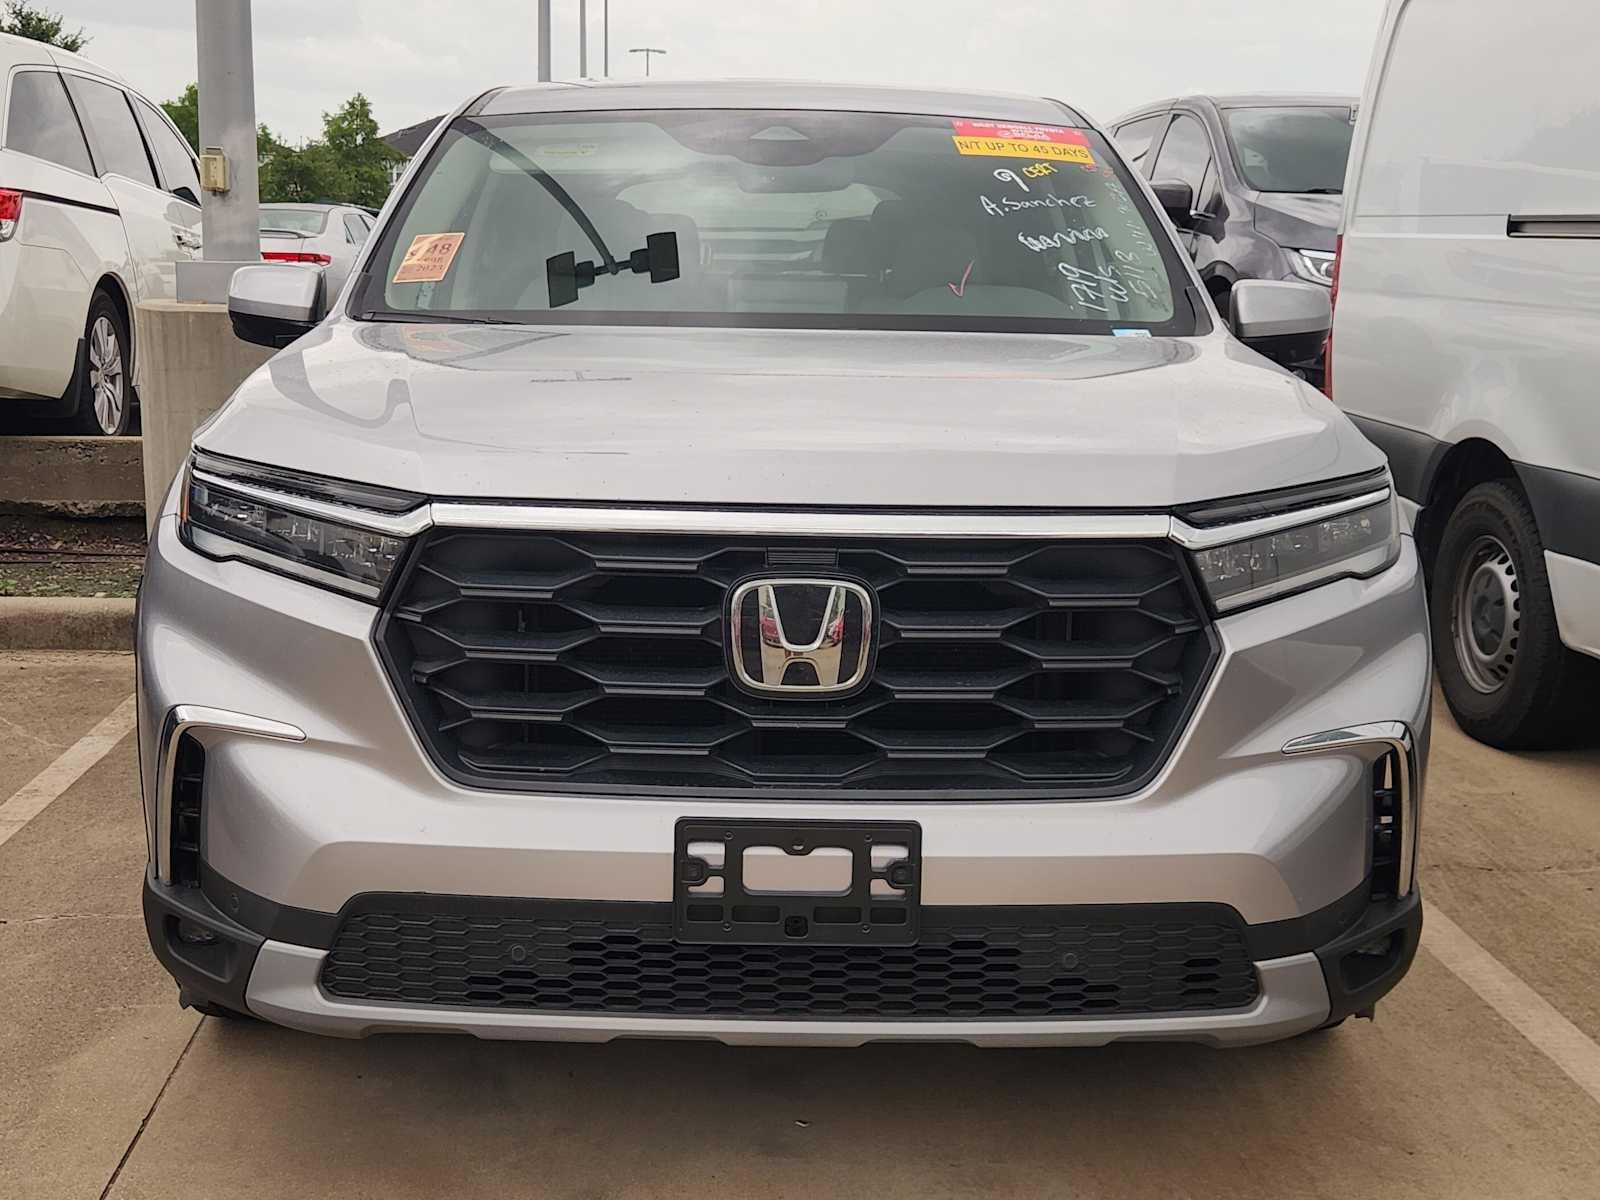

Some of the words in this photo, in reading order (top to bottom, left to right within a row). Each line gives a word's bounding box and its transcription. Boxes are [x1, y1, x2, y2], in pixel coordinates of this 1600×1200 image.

[957, 140, 982, 151] N/T
[985, 141, 1005, 151] UP
[1007, 143, 1029, 153] TO
[1032, 144, 1049, 155] 45
[1051, 146, 1089, 159] DAYS
